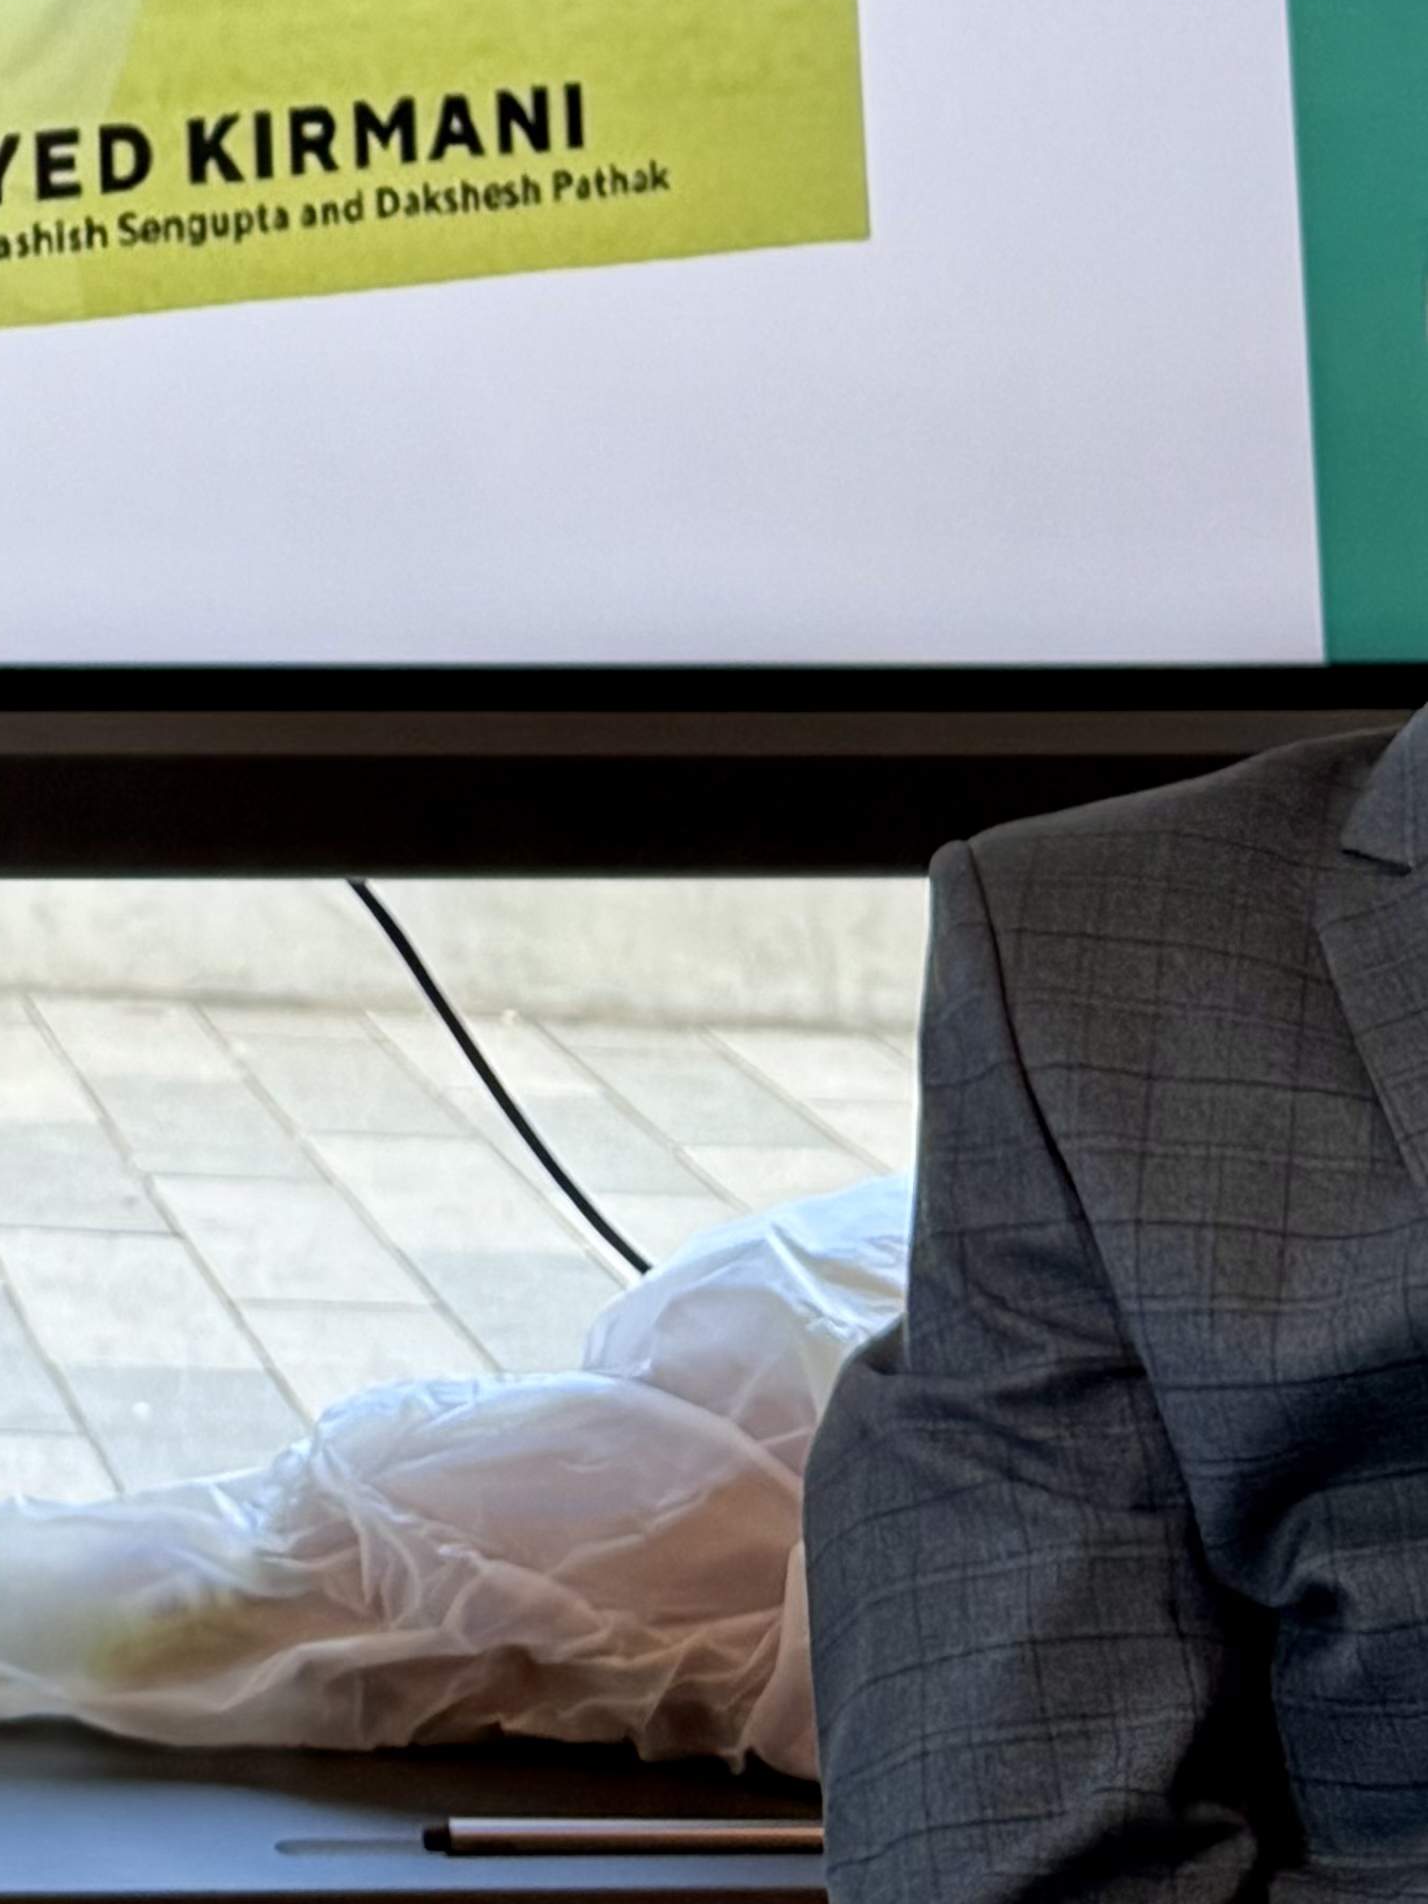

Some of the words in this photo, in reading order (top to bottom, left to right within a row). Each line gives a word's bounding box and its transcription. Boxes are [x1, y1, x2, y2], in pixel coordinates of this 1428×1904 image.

[186, 82, 586, 186] KIRMANI
[118, 202, 290, 251] Sengupta
[299, 193, 366, 228] and
[375, 178, 543, 220] Dakshesh
[552, 160, 671, 204] Pathak
